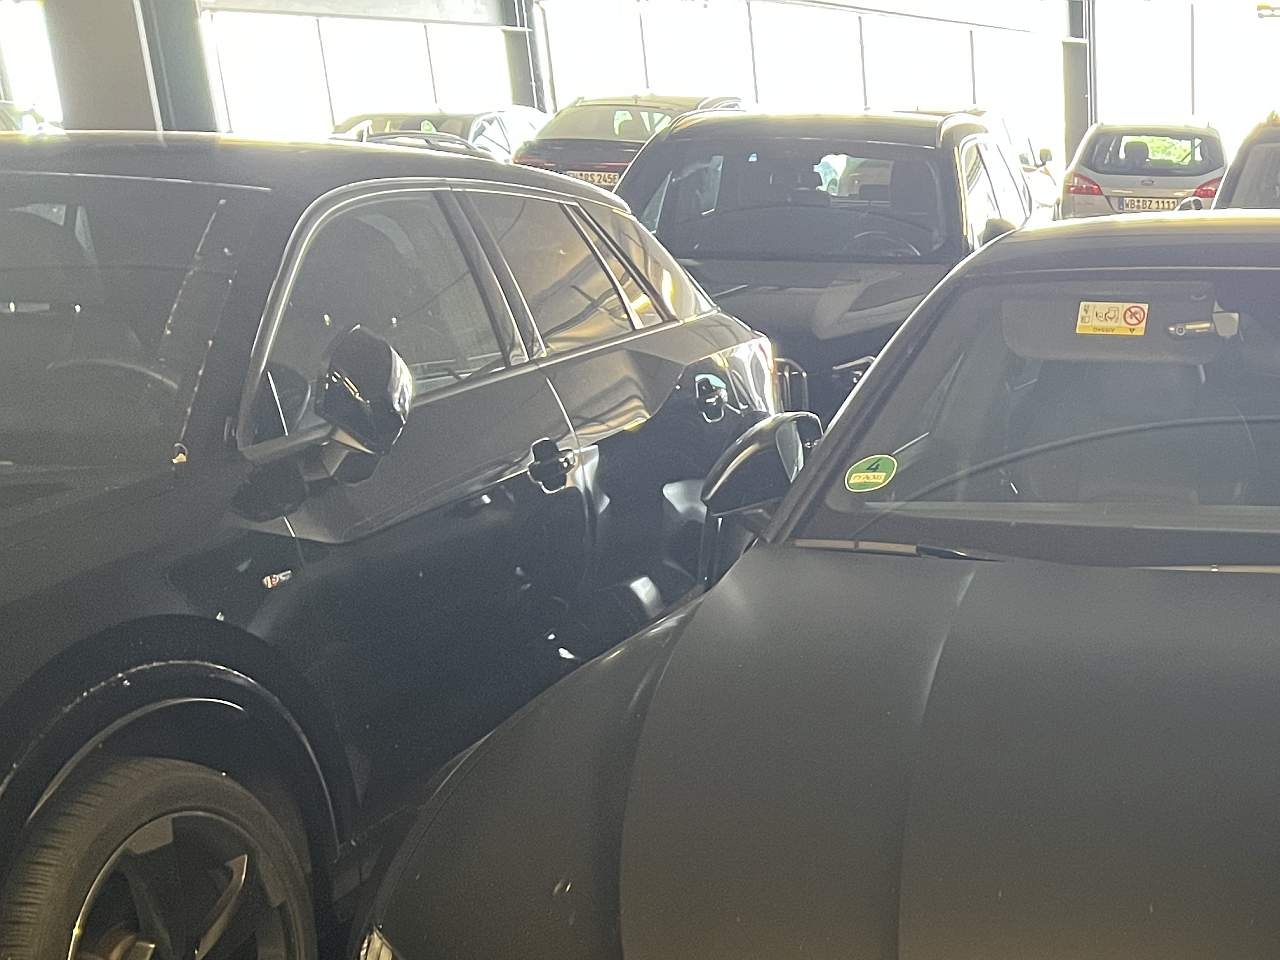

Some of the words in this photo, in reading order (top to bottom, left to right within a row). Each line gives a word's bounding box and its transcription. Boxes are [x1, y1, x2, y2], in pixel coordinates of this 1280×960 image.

[1124, 199, 1136, 209] WB
[1155, 200, 1176, 210] 1111
[865, 458, 882, 472] 4
